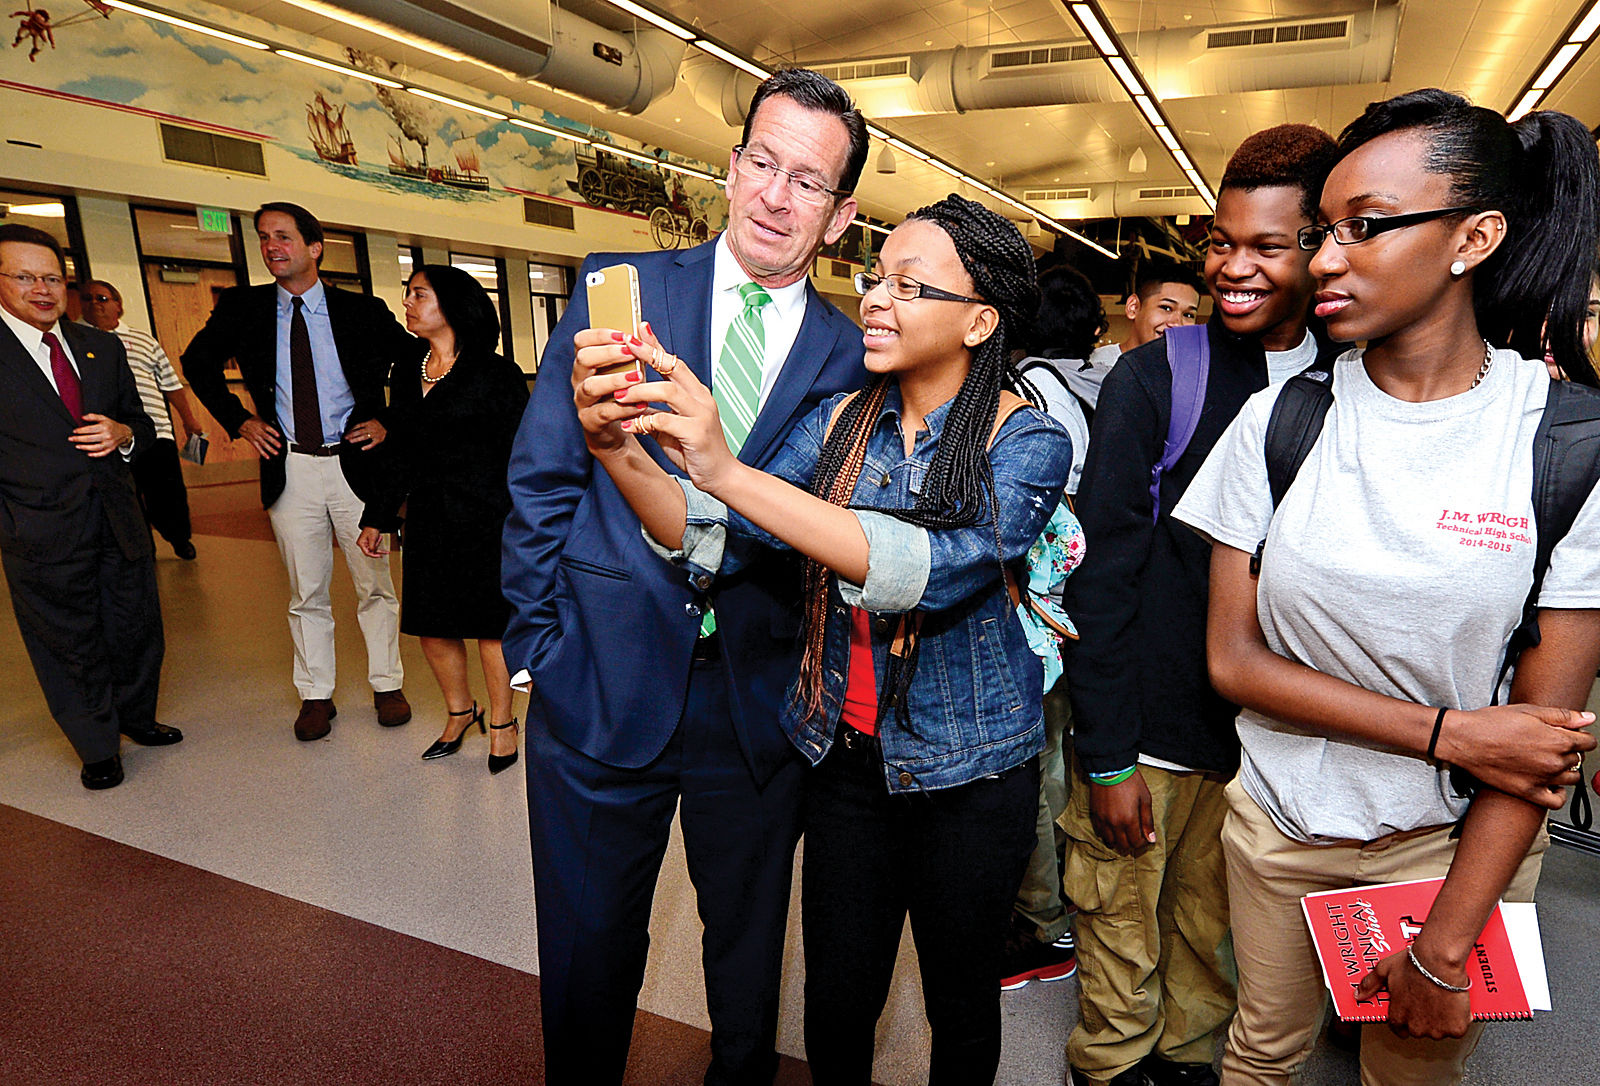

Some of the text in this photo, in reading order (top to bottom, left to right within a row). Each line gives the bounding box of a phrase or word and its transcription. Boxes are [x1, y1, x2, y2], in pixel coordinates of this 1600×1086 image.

[203, 209, 229, 232] EXIT
[1436, 522, 1482, 535] Technical
[1484, 527, 1507, 539] High
[1439, 510, 1528, 529] J.M. WRIGH
[1460, 537, 1511, 552] 2014-2015
[1326, 902, 1361, 976] WRIGHT
[1356, 901, 1392, 953] School
[1347, 898, 1391, 1007] THNICAL
[1473, 942, 1498, 993] STUDENT
